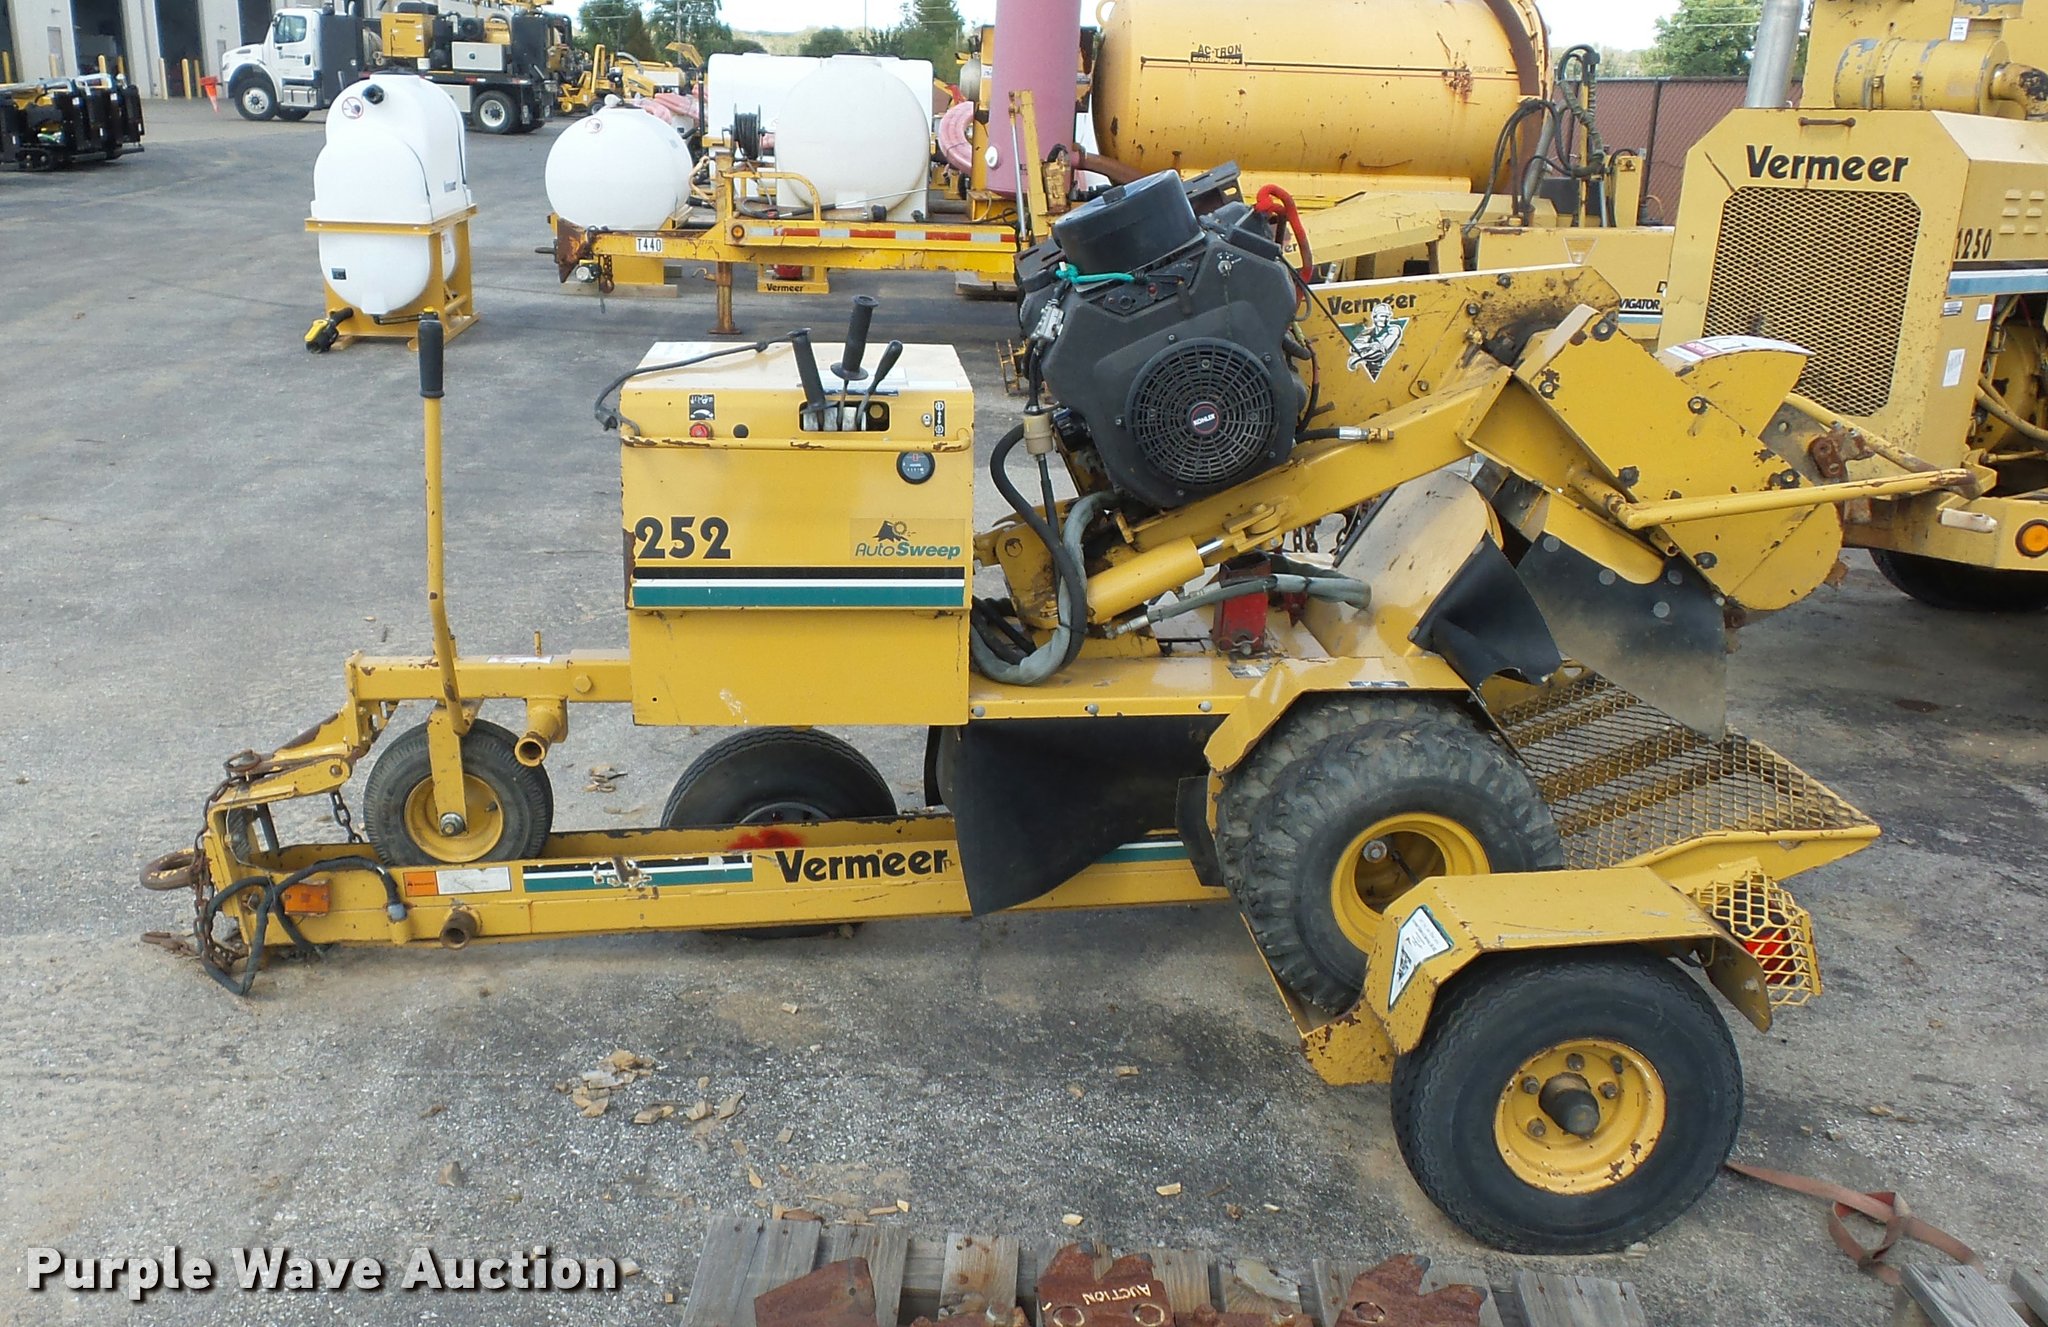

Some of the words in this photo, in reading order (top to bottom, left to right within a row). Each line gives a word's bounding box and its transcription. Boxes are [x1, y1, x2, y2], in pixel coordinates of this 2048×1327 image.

[1745, 144, 1909, 183] Vermeer
[637, 238, 662, 252] T440
[1955, 228, 1992, 259] 1250
[766, 283, 804, 292] Vermeer
[1327, 294, 1417, 315] Vermeer
[634, 517, 731, 559] 252
[855, 541, 961, 559] AutoSweep
[775, 849, 948, 883] Vermeer
[1082, 1283, 1152, 1305] AUCTION
